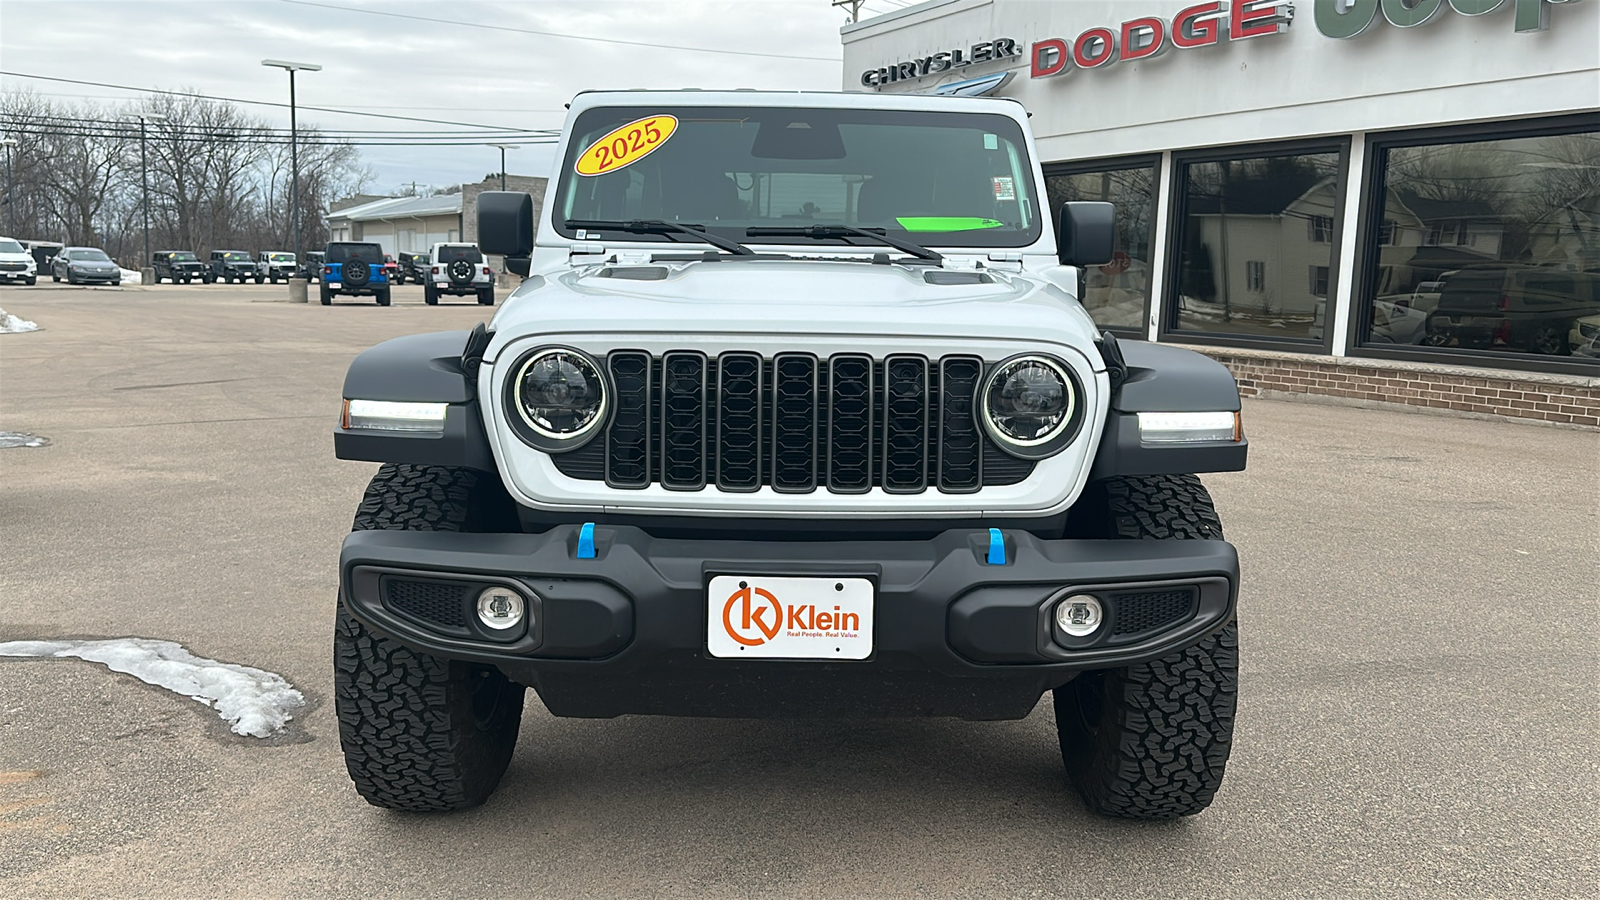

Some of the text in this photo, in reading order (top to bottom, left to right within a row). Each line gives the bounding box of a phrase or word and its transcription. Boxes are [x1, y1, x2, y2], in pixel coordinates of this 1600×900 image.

[861, 38, 1016, 87] CHRYSLER
[1031, 0, 1280, 79] DODGE
[595, 120, 661, 171] 2025
[787, 605, 859, 631] Klein
